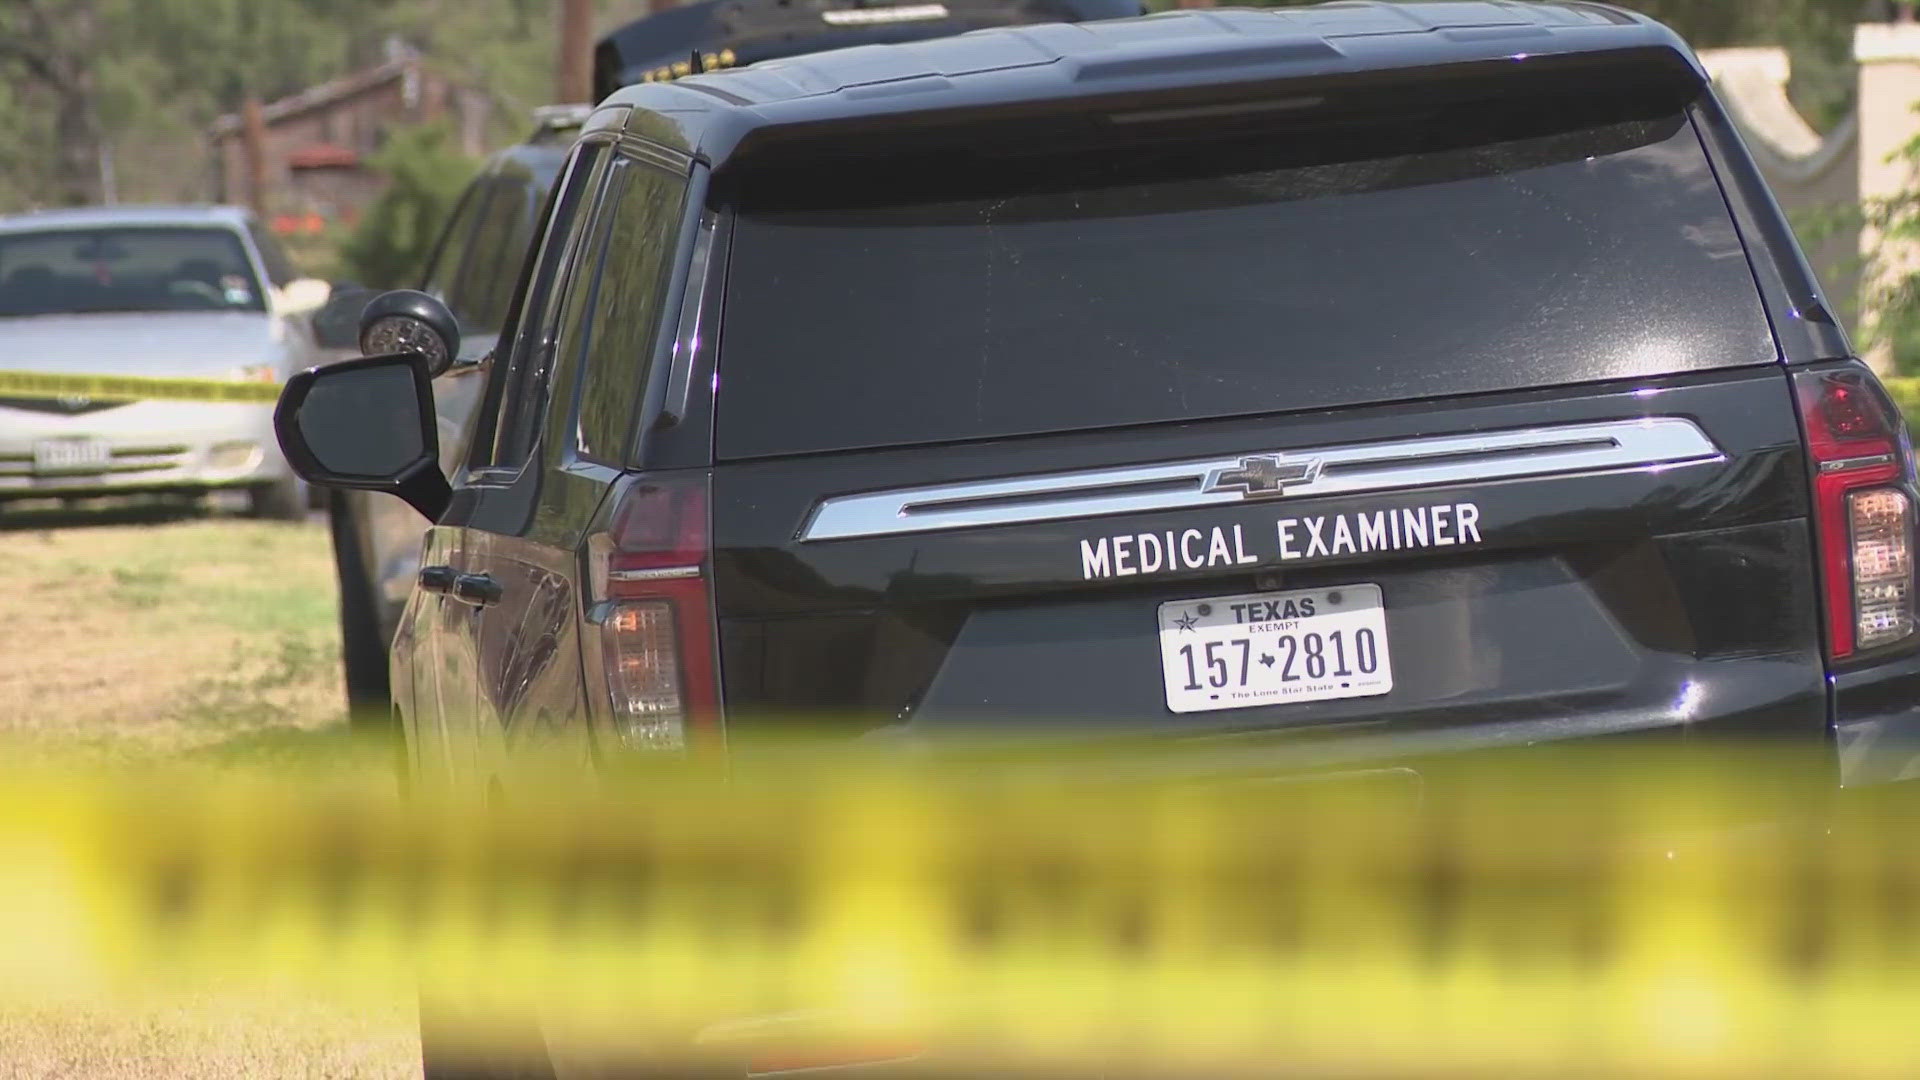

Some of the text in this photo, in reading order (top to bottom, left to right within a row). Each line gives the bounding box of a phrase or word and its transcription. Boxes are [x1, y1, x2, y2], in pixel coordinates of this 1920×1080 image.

[1080, 503, 1482, 580] MEDICAL EXAMINER
[1230, 598, 1316, 624] TEXAS
[1249, 621, 1300, 633] EXEMPT
[1179, 627, 1377, 691] 157 2810
[1253, 689, 1279, 697] Lone
[1281, 686, 1303, 695] Star
[1306, 684, 1334, 692] State
